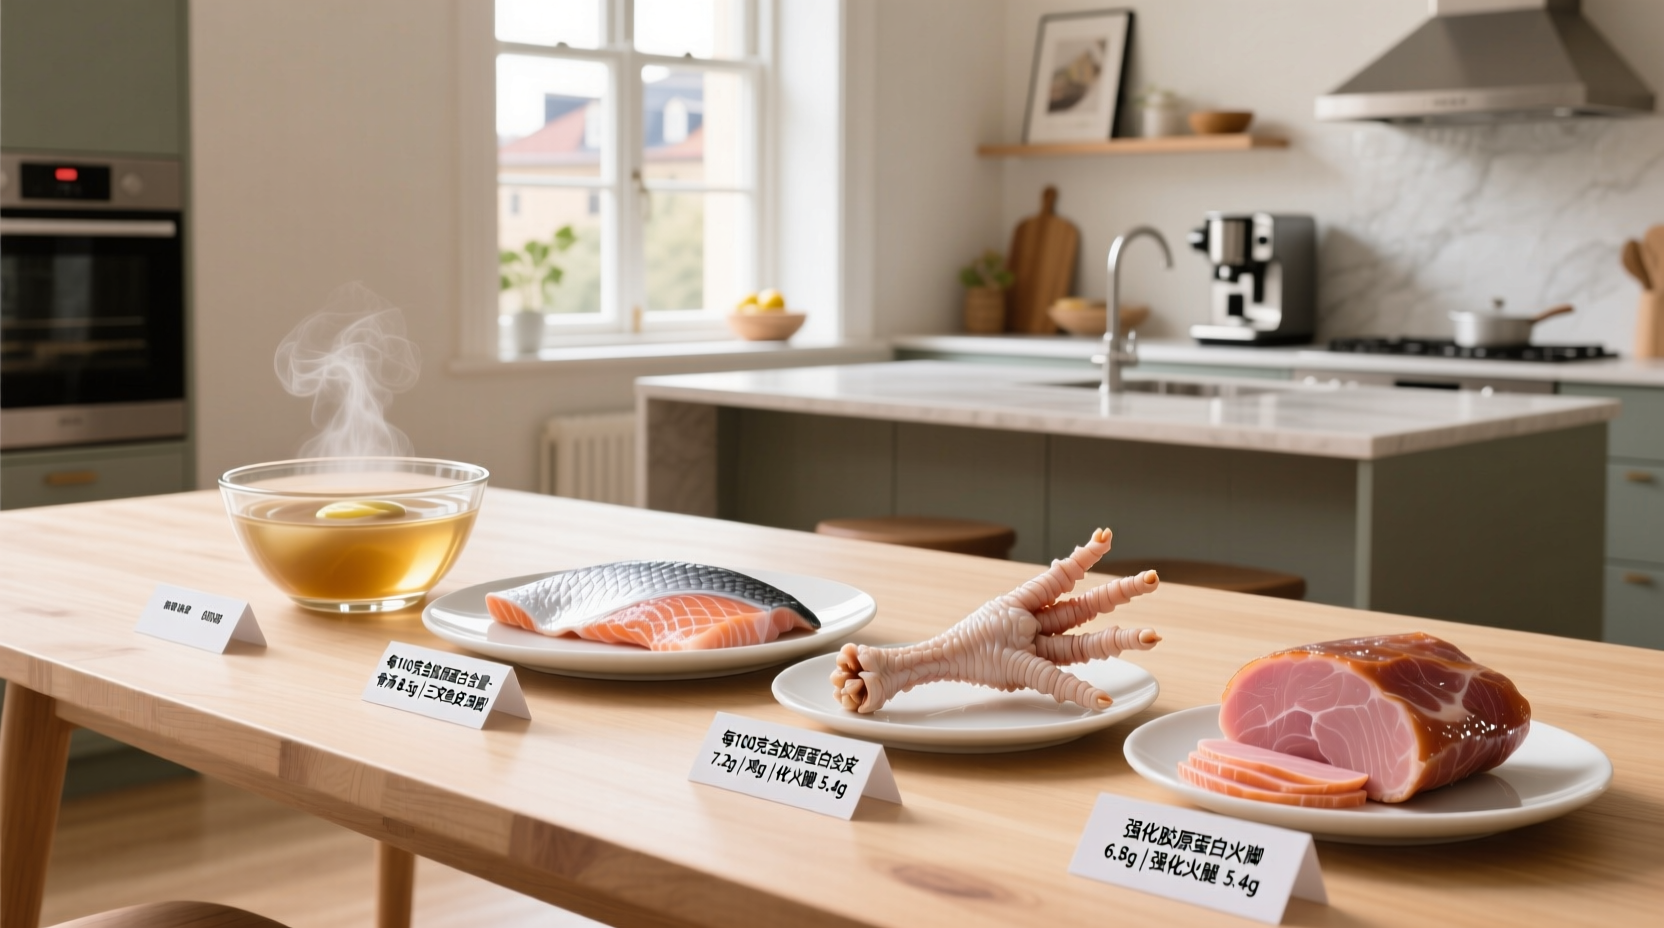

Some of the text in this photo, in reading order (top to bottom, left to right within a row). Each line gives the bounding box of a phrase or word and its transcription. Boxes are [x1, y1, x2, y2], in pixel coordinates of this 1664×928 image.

[710, 751, 738, 773] 7.2g
[1104, 842, 1138, 869] 6.8g
[1149, 850, 1221, 885] 强化火腿
[1222, 869, 1260, 898] 5.4g
